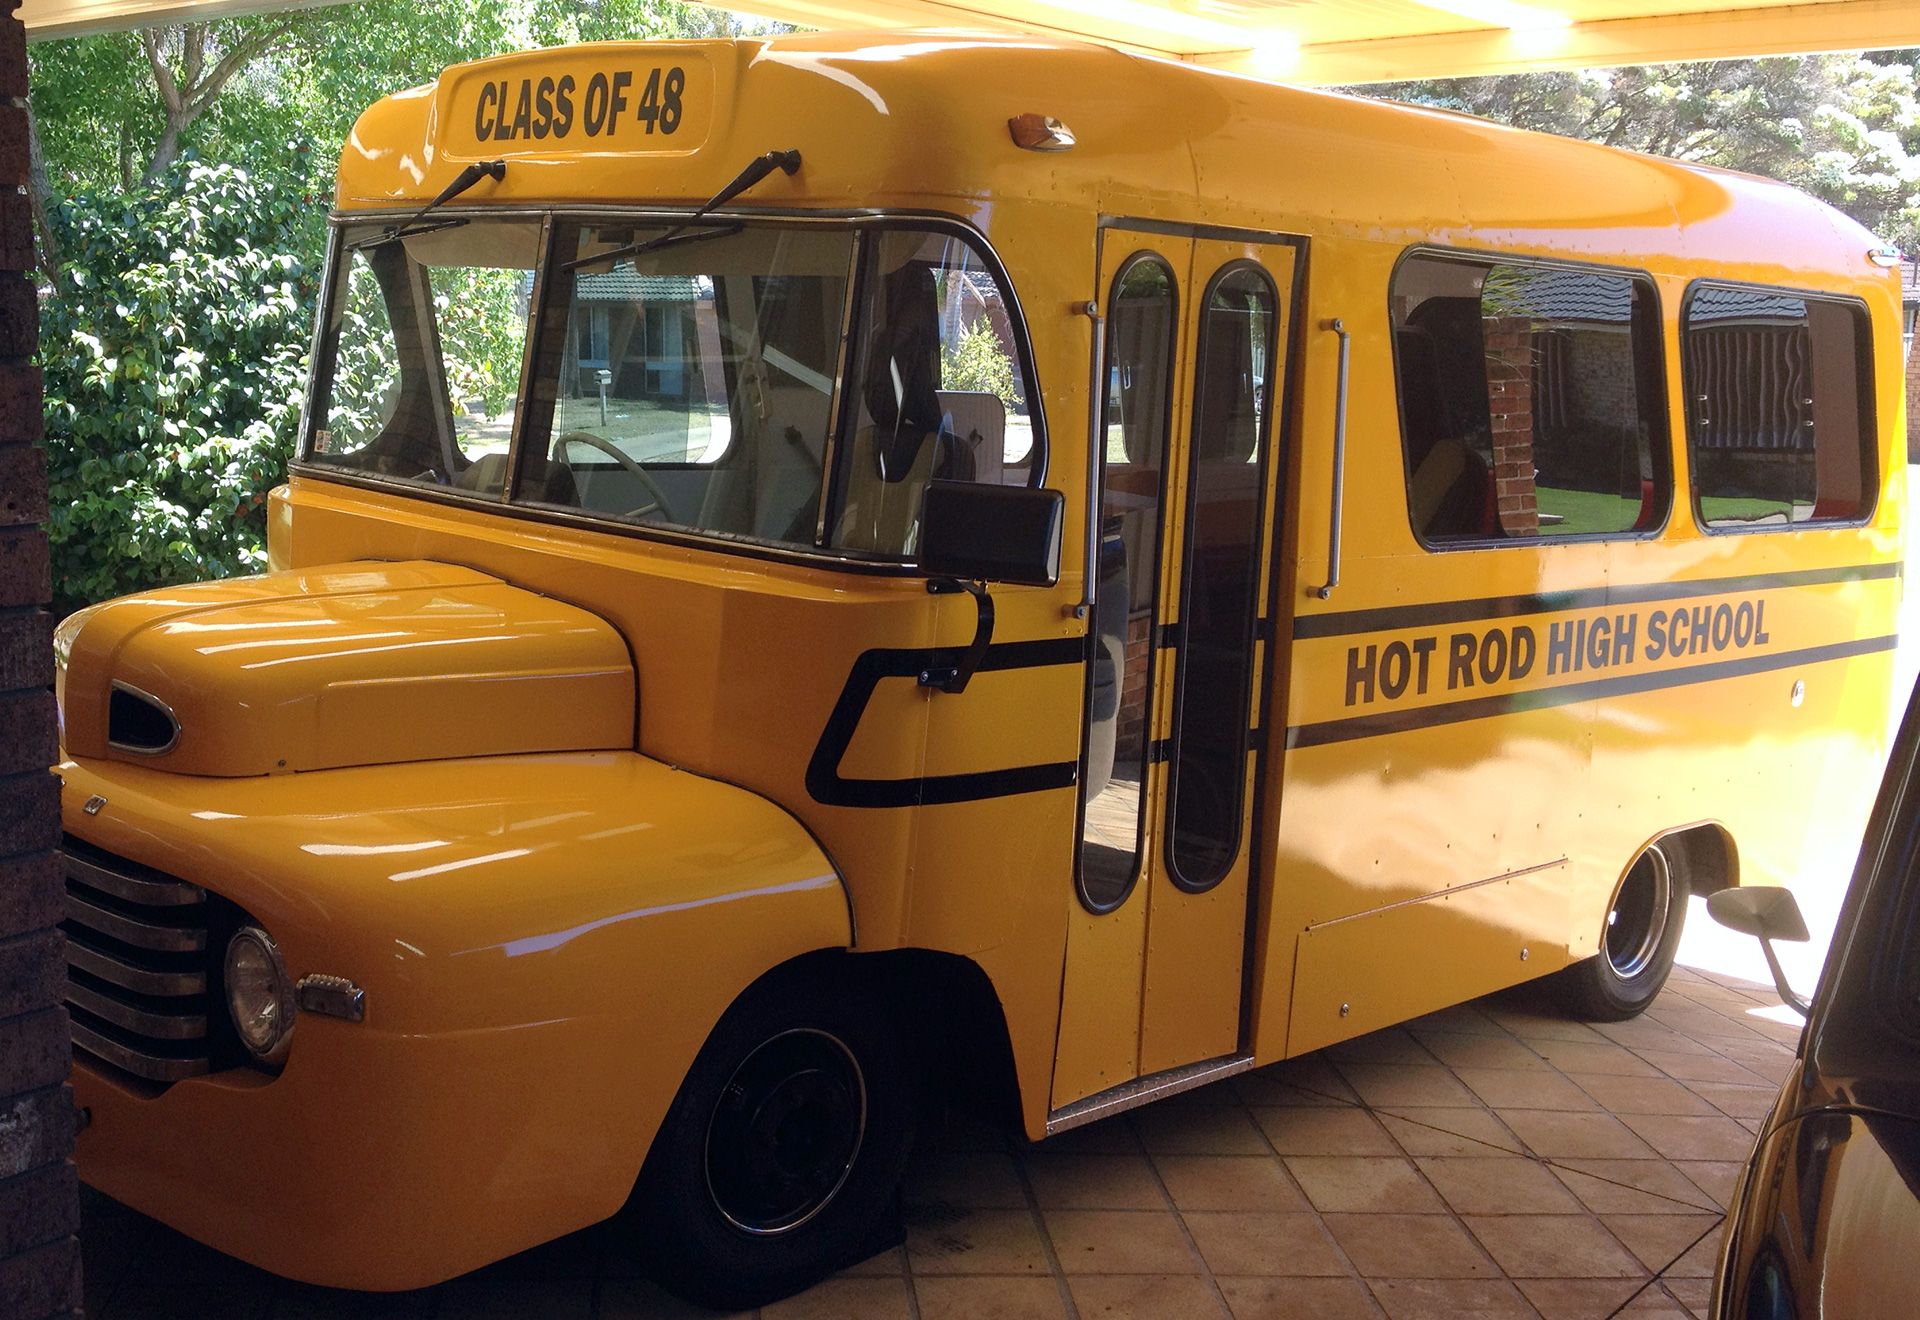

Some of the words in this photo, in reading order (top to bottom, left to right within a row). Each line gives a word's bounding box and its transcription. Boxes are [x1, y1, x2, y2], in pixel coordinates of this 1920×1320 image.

[475, 75, 575, 142] CLASS
[583, 71, 632, 137] OF
[637, 67, 685, 135] 48
[1344, 637, 1436, 706] HOT
[1447, 625, 1536, 690] ROD
[1546, 613, 1638, 676] HIGH
[1644, 599, 1770, 660] SCHOOL
